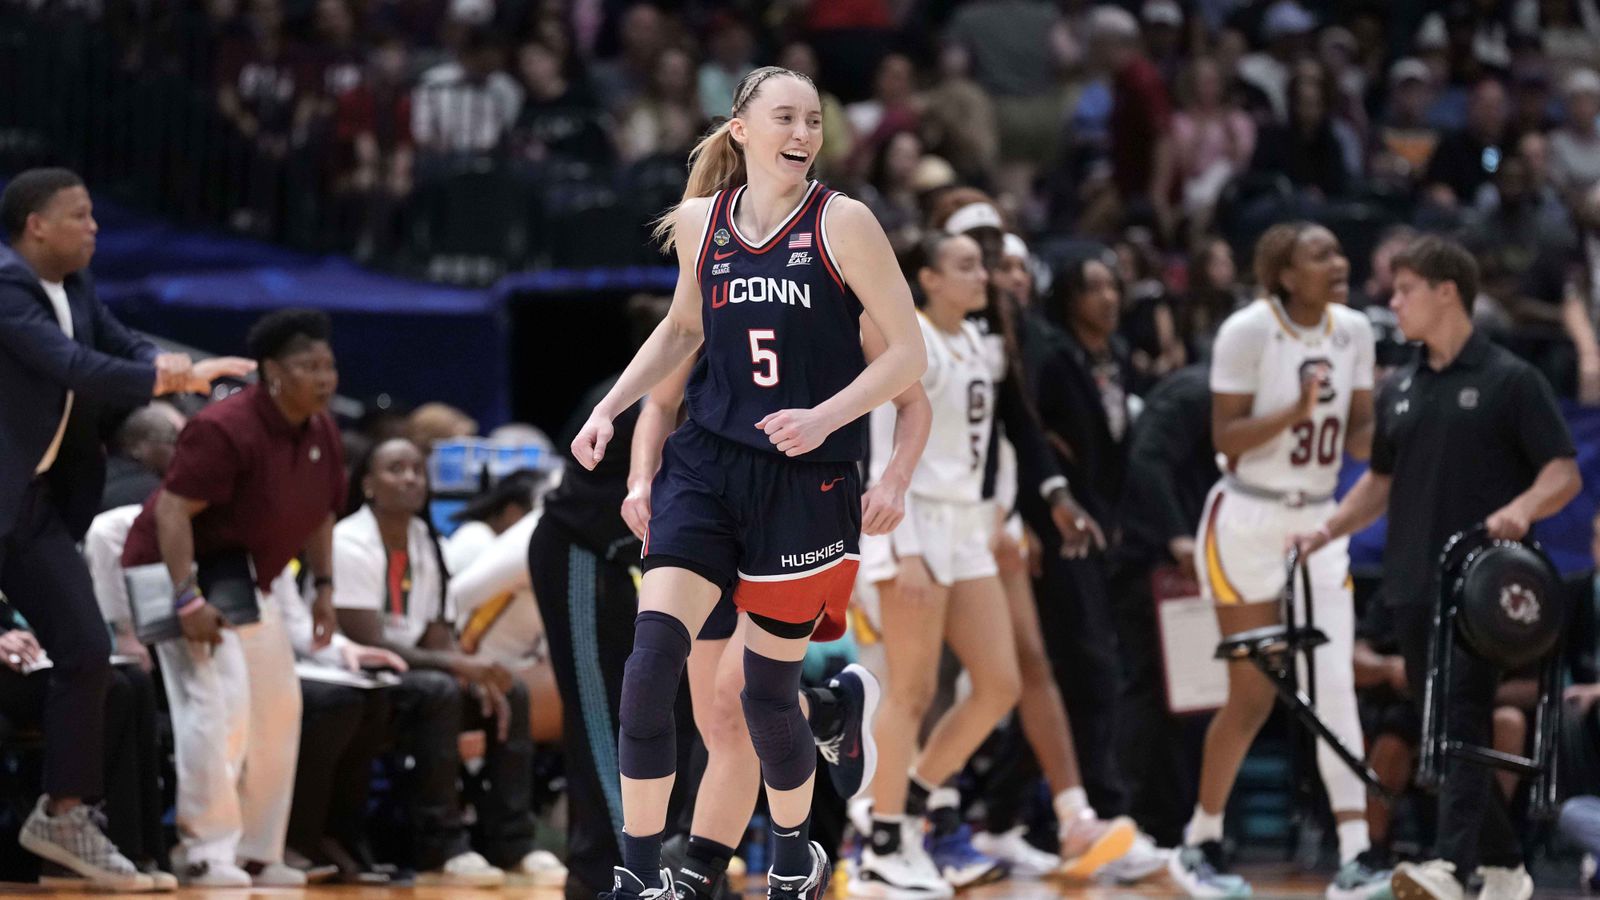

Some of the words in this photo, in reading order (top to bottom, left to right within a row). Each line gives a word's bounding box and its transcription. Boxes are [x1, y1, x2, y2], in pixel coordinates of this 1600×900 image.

[711, 268, 730, 276] CHANGE
[712, 277, 811, 308] UCONN
[748, 328, 779, 387] 5
[1290, 417, 1340, 466] 30
[781, 540, 844, 568] HUSKIES
